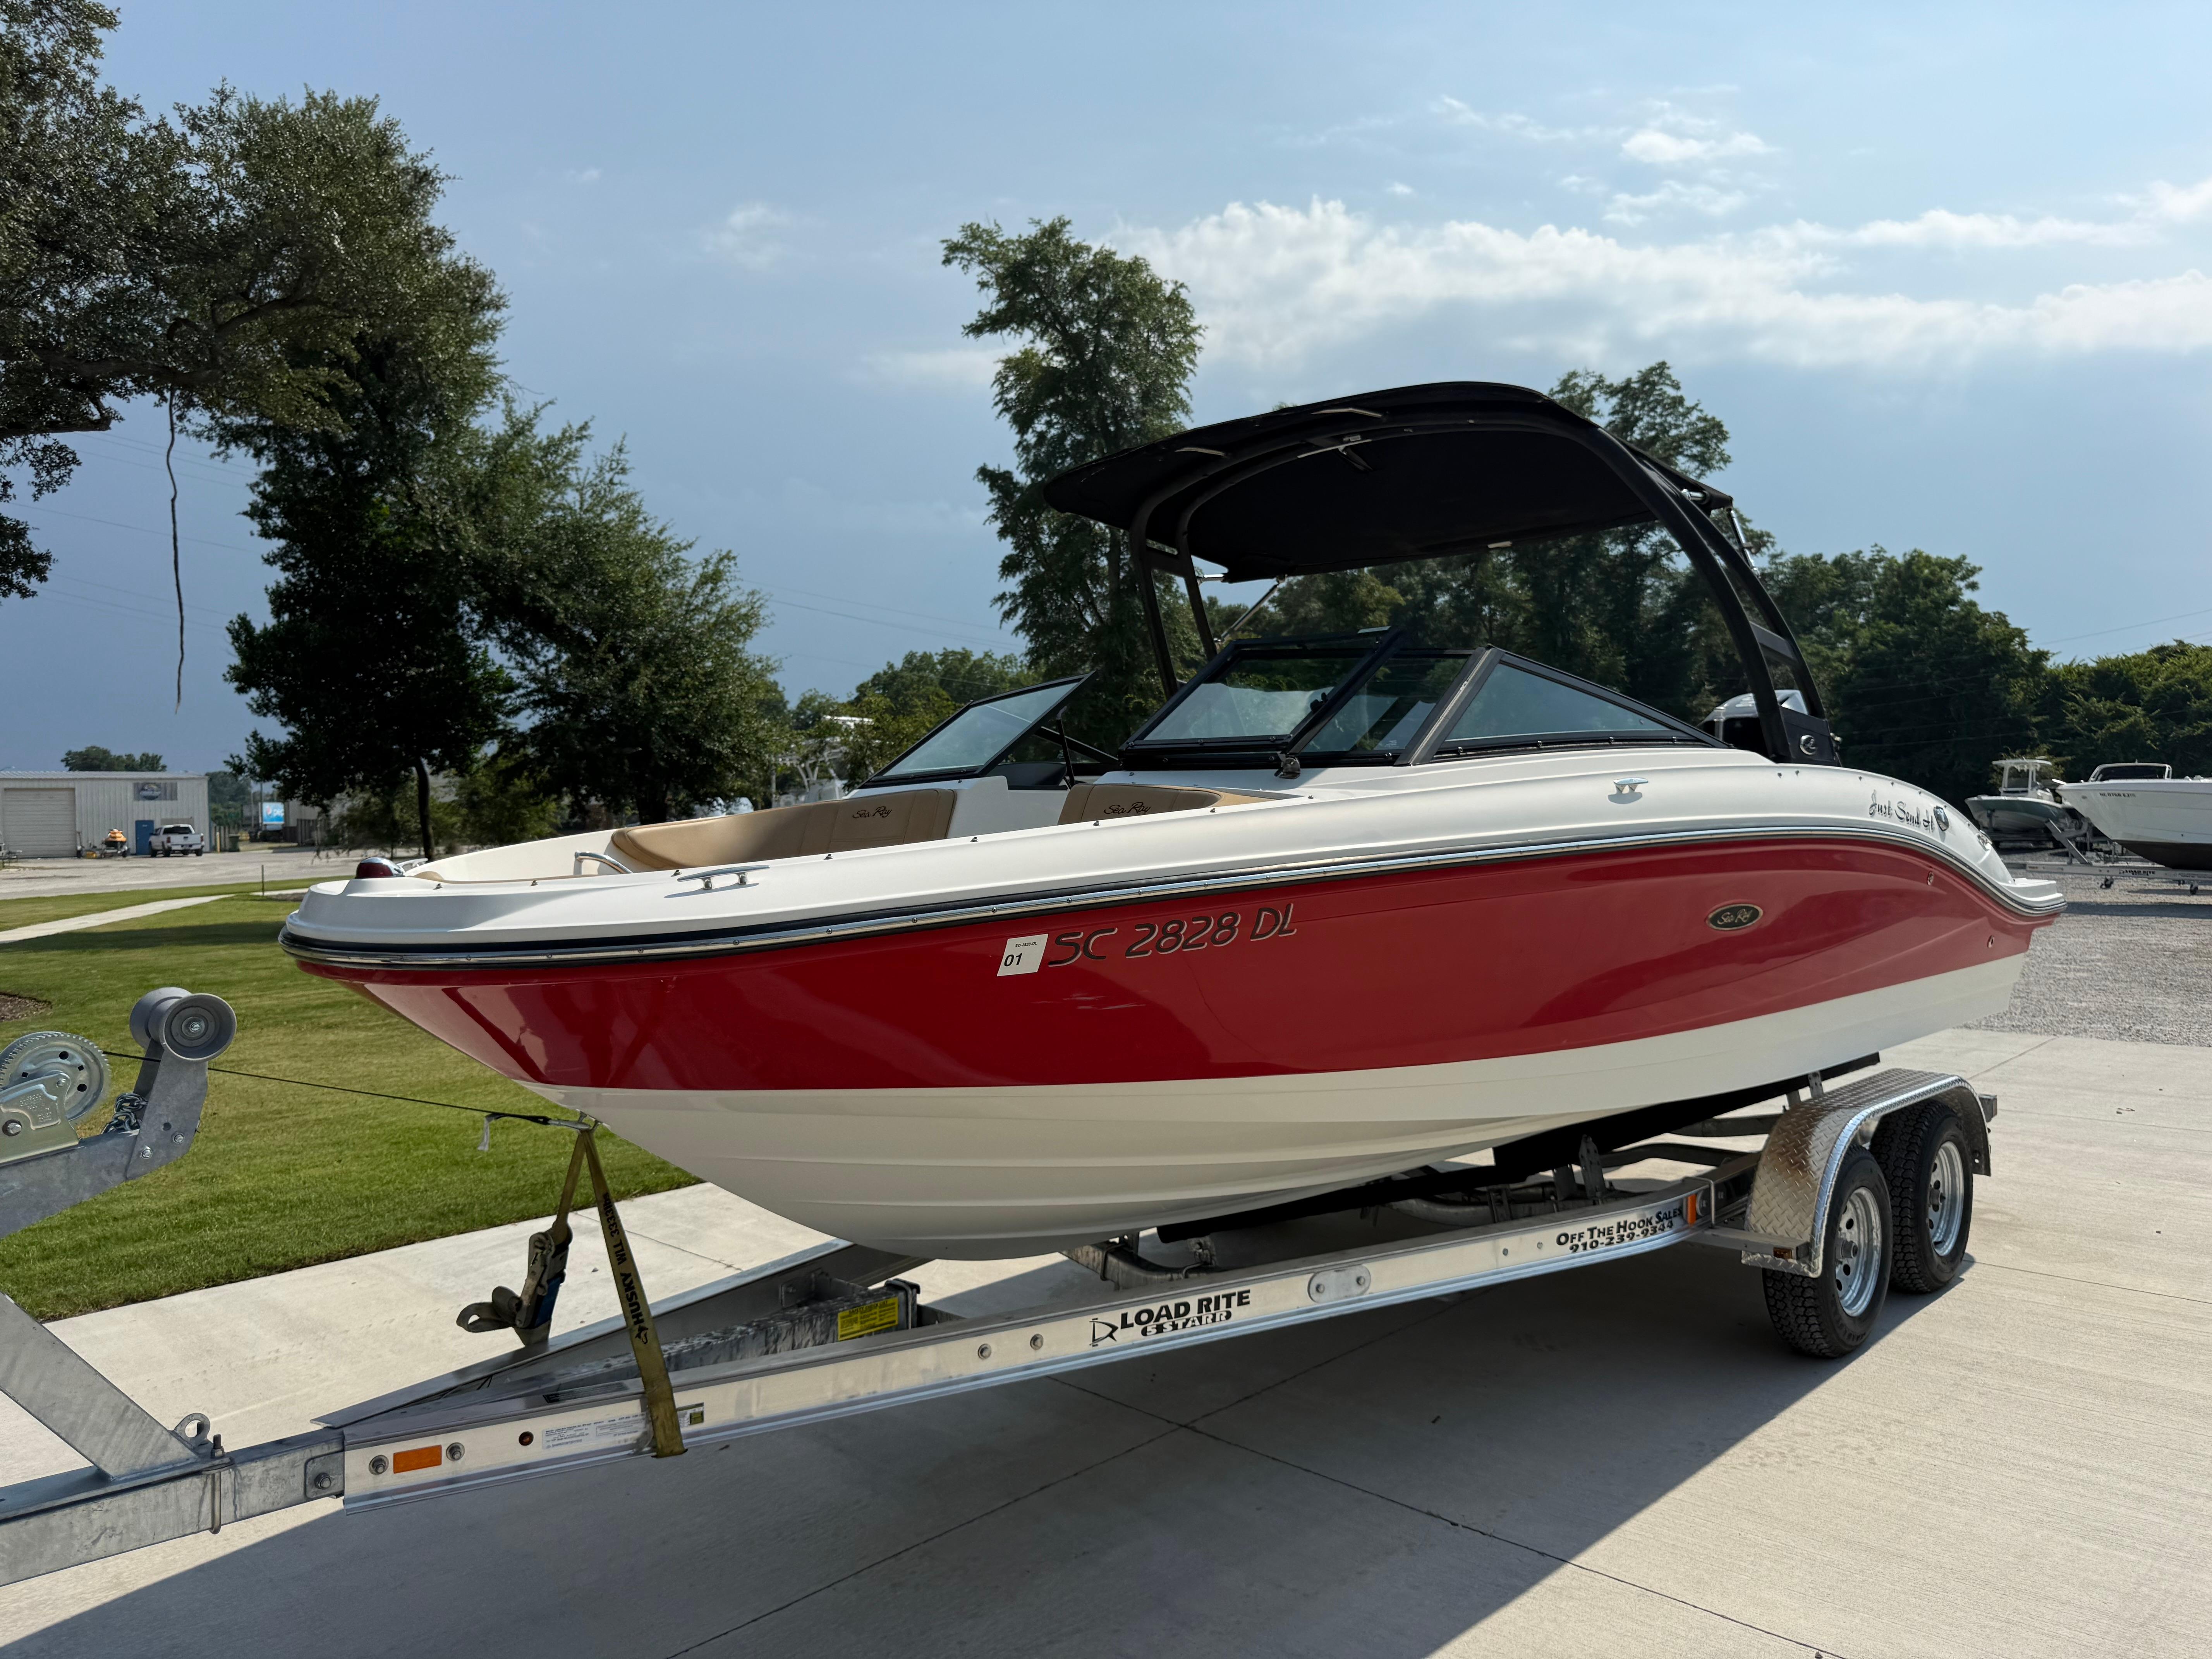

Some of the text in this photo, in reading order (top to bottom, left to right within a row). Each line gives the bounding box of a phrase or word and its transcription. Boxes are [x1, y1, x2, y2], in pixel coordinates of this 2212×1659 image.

[852, 806, 892, 819] Sea Ray
[1104, 804, 1126, 814] Sea
[1894, 801, 1921, 827] Send
[1048, 903, 1297, 967] SC 2828 DL
[1004, 953, 1022, 967] 01
[613, 1239, 627, 1266] WLL
[620, 1272, 645, 1326] HUSKY
[1120, 1289, 1250, 1330] LOAD RITE
[1163, 1310, 1228, 1333] STARR
